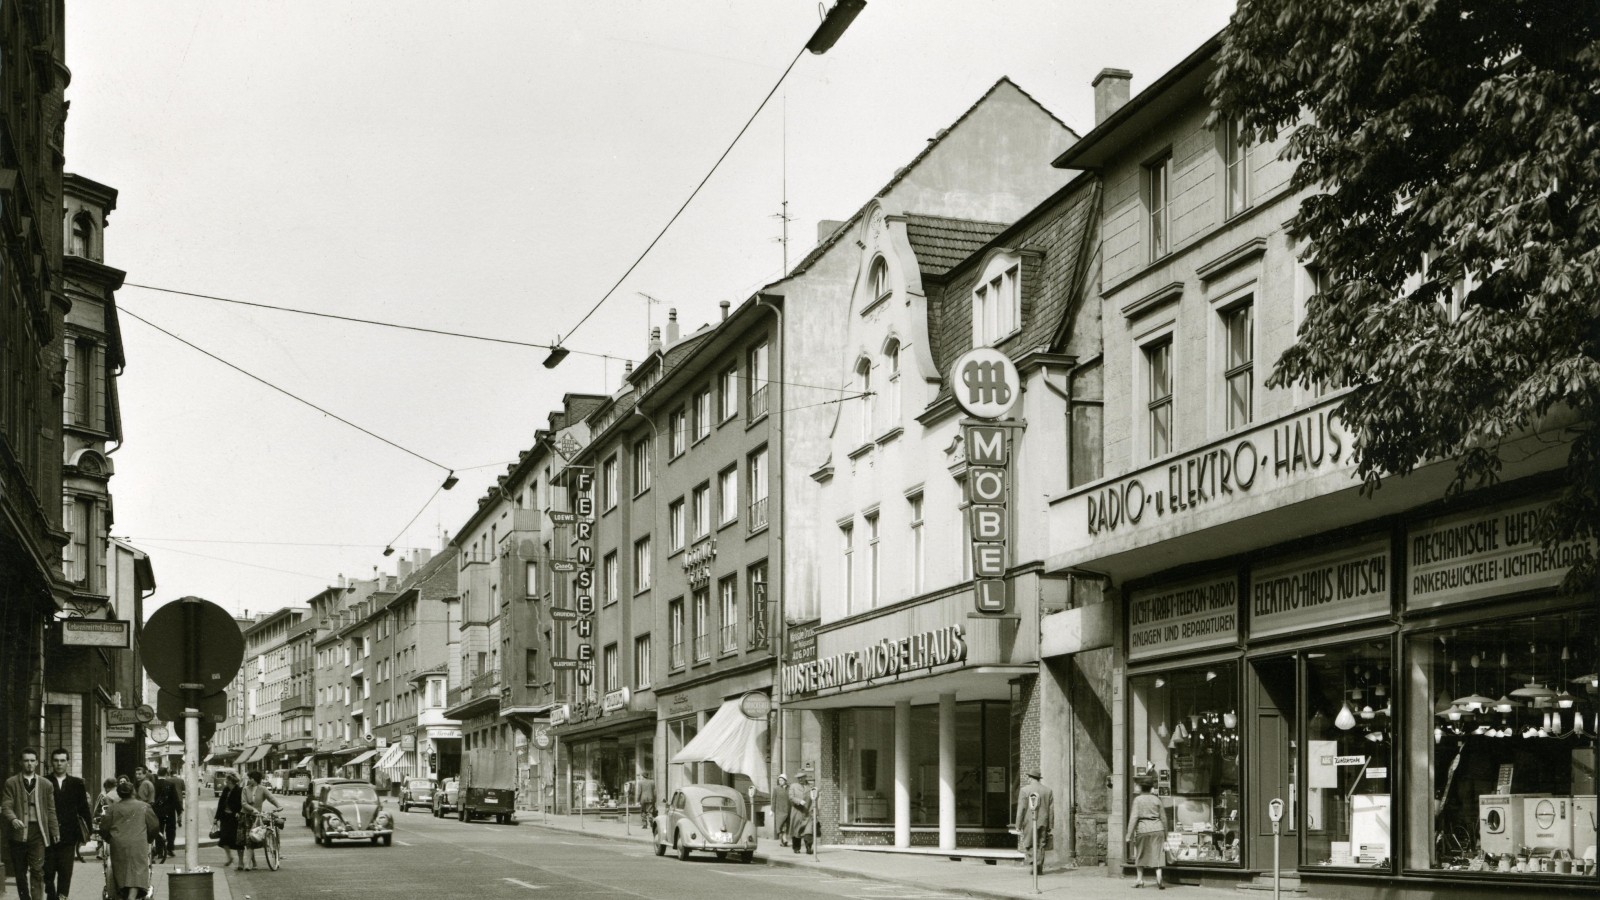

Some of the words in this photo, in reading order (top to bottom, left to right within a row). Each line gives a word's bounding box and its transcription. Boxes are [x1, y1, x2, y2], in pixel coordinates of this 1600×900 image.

[973, 431, 1003, 606] MÖBEL
[1413, 518, 1499, 566] MECHANISCHE
[579, 474, 591, 685] FERNSEHEN
[1337, 555, 1386, 600] KUTSCH
[1413, 560, 1498, 595] ANKERWICKELEI
[756, 584, 766, 648] ALLIANZ
[1132, 628, 1162, 647] ANLAGEN
[1164, 625, 1179, 642] UND
[1182, 613, 1235, 639] REPARATUREN
[782, 650, 861, 702] MUSTERRING
